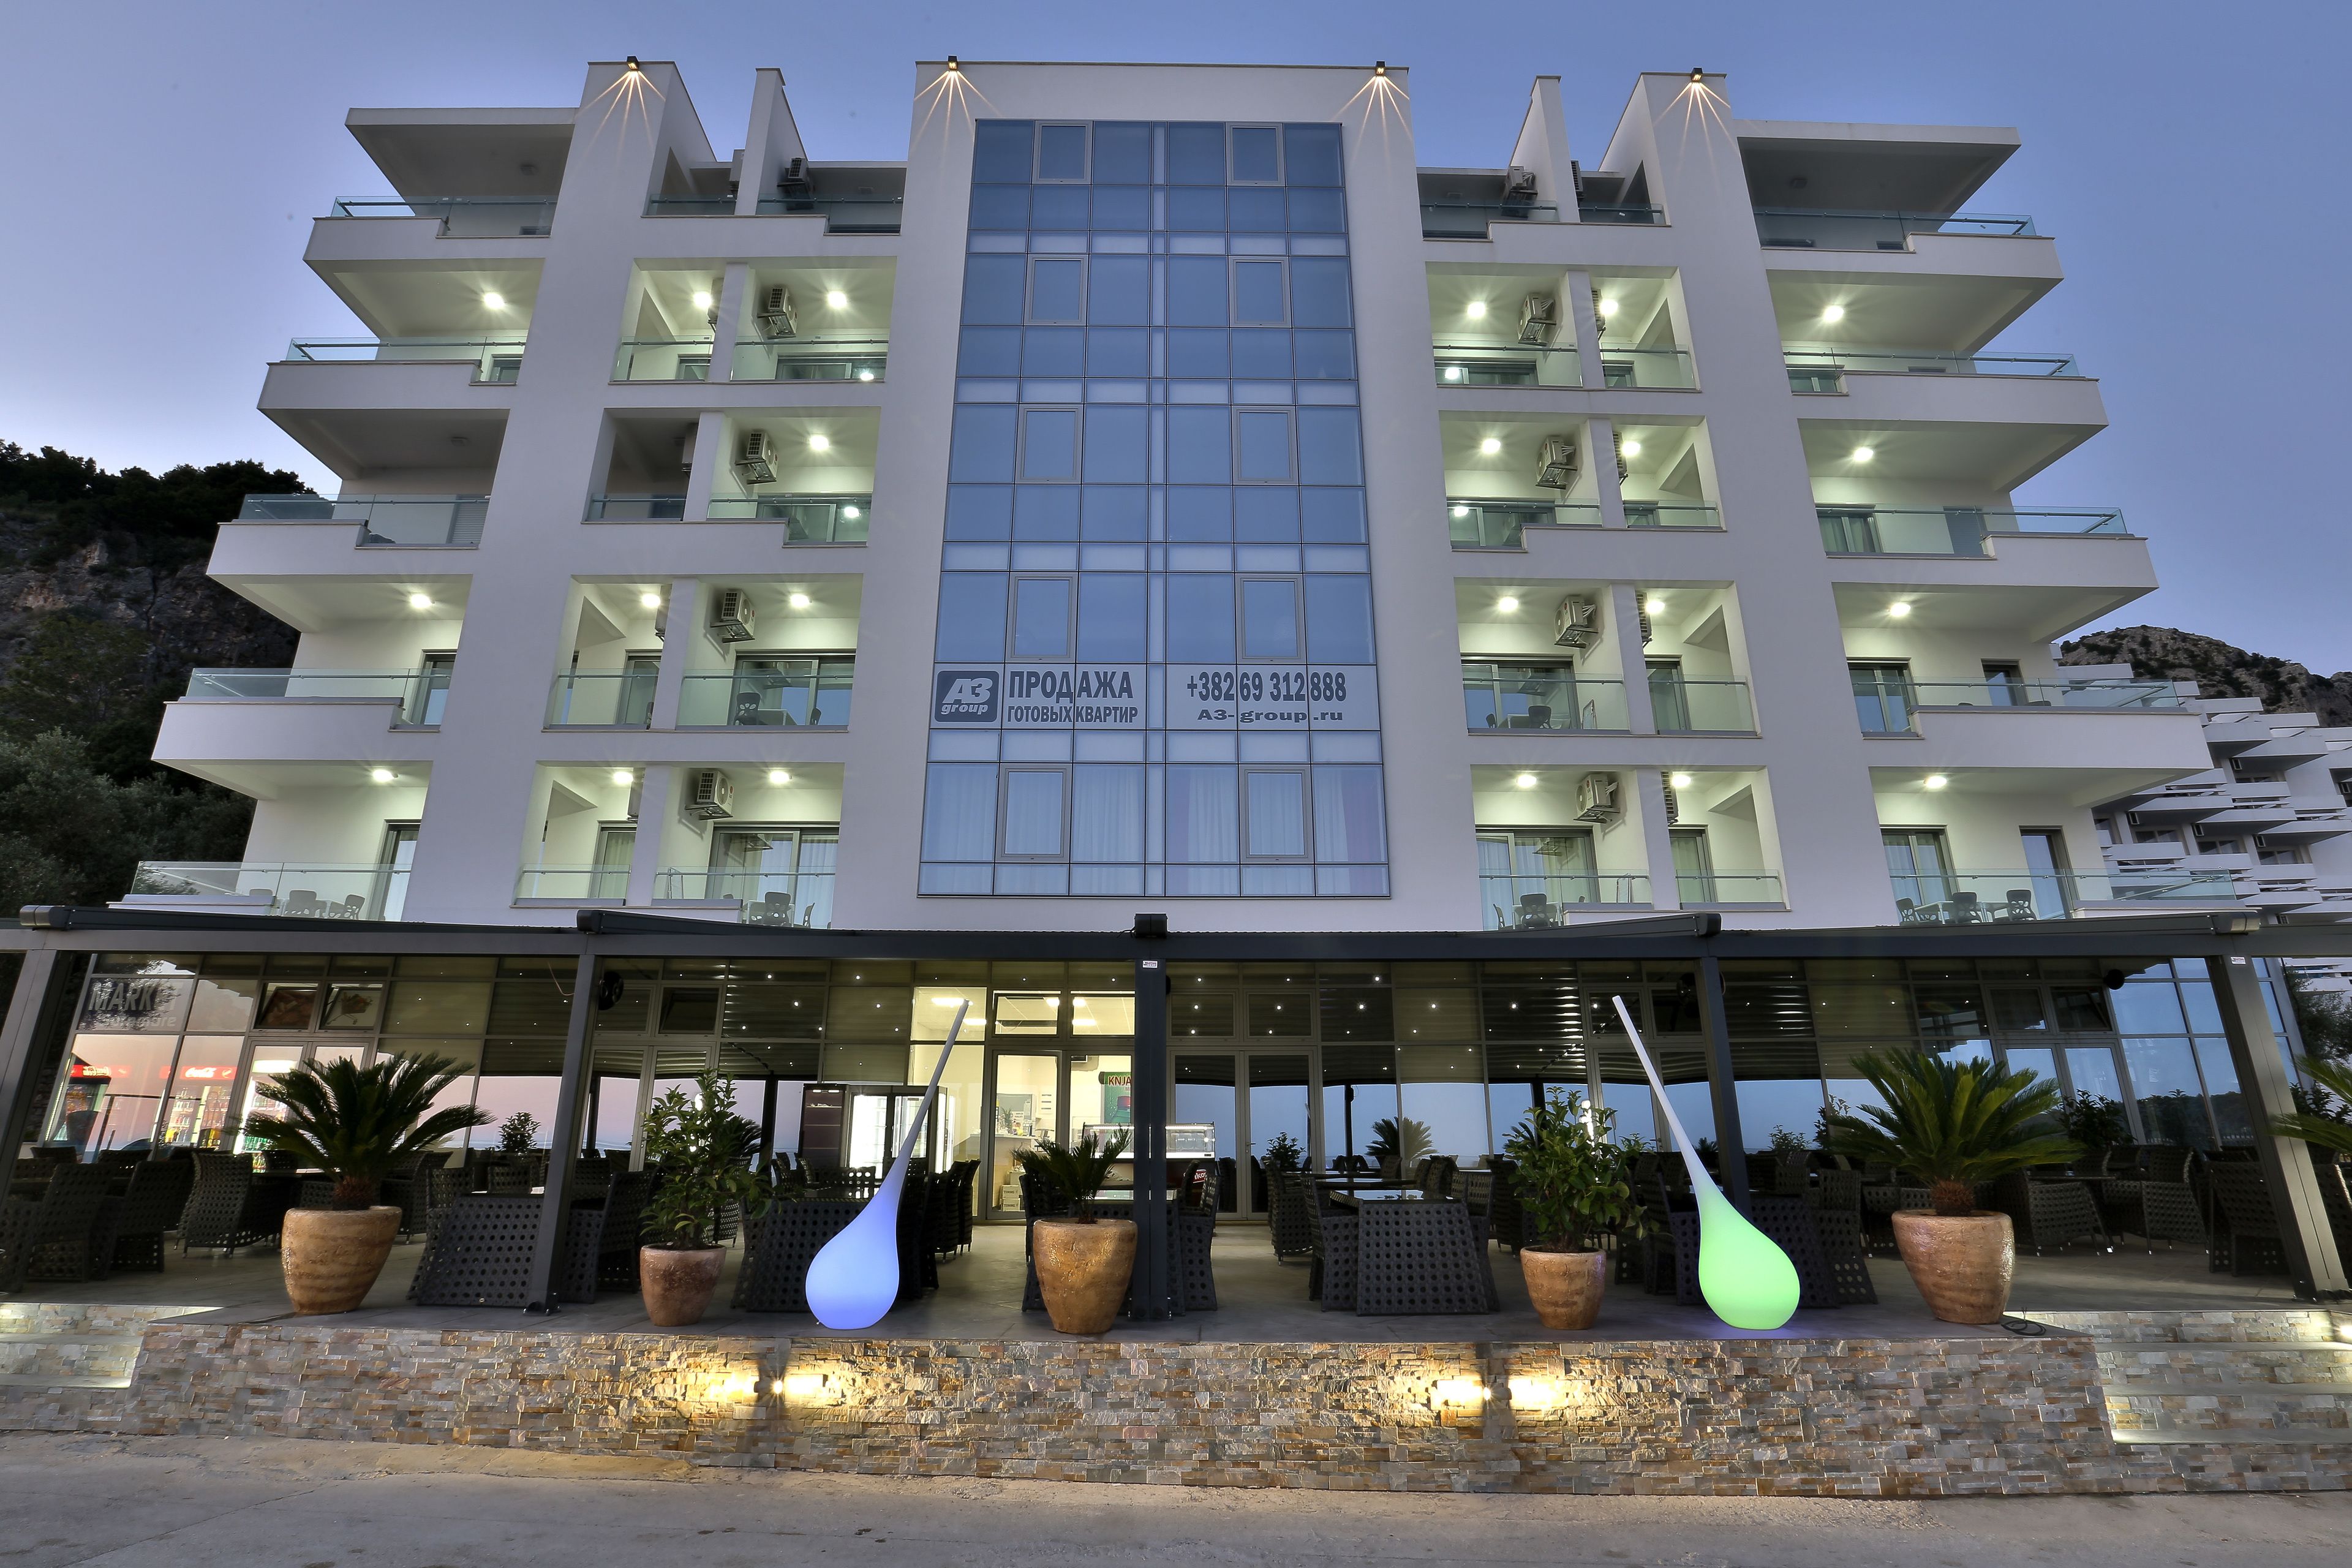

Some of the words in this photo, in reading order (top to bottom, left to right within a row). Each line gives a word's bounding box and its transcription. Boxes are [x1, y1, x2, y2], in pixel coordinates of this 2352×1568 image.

[942, 677, 993, 704] A3
[1009, 670, 1134, 704] ПРОДАЖА
[1187, 671, 1235, 701] +382
[1239, 671, 1263, 702] 69
[1269, 671, 1306, 701] 312
[1310, 671, 1347, 702] 888
[941, 704, 988, 715] group
[1007, 706, 1072, 722] ГОТОВЫХ
[1075, 706, 1138, 723] КВАРТИР
